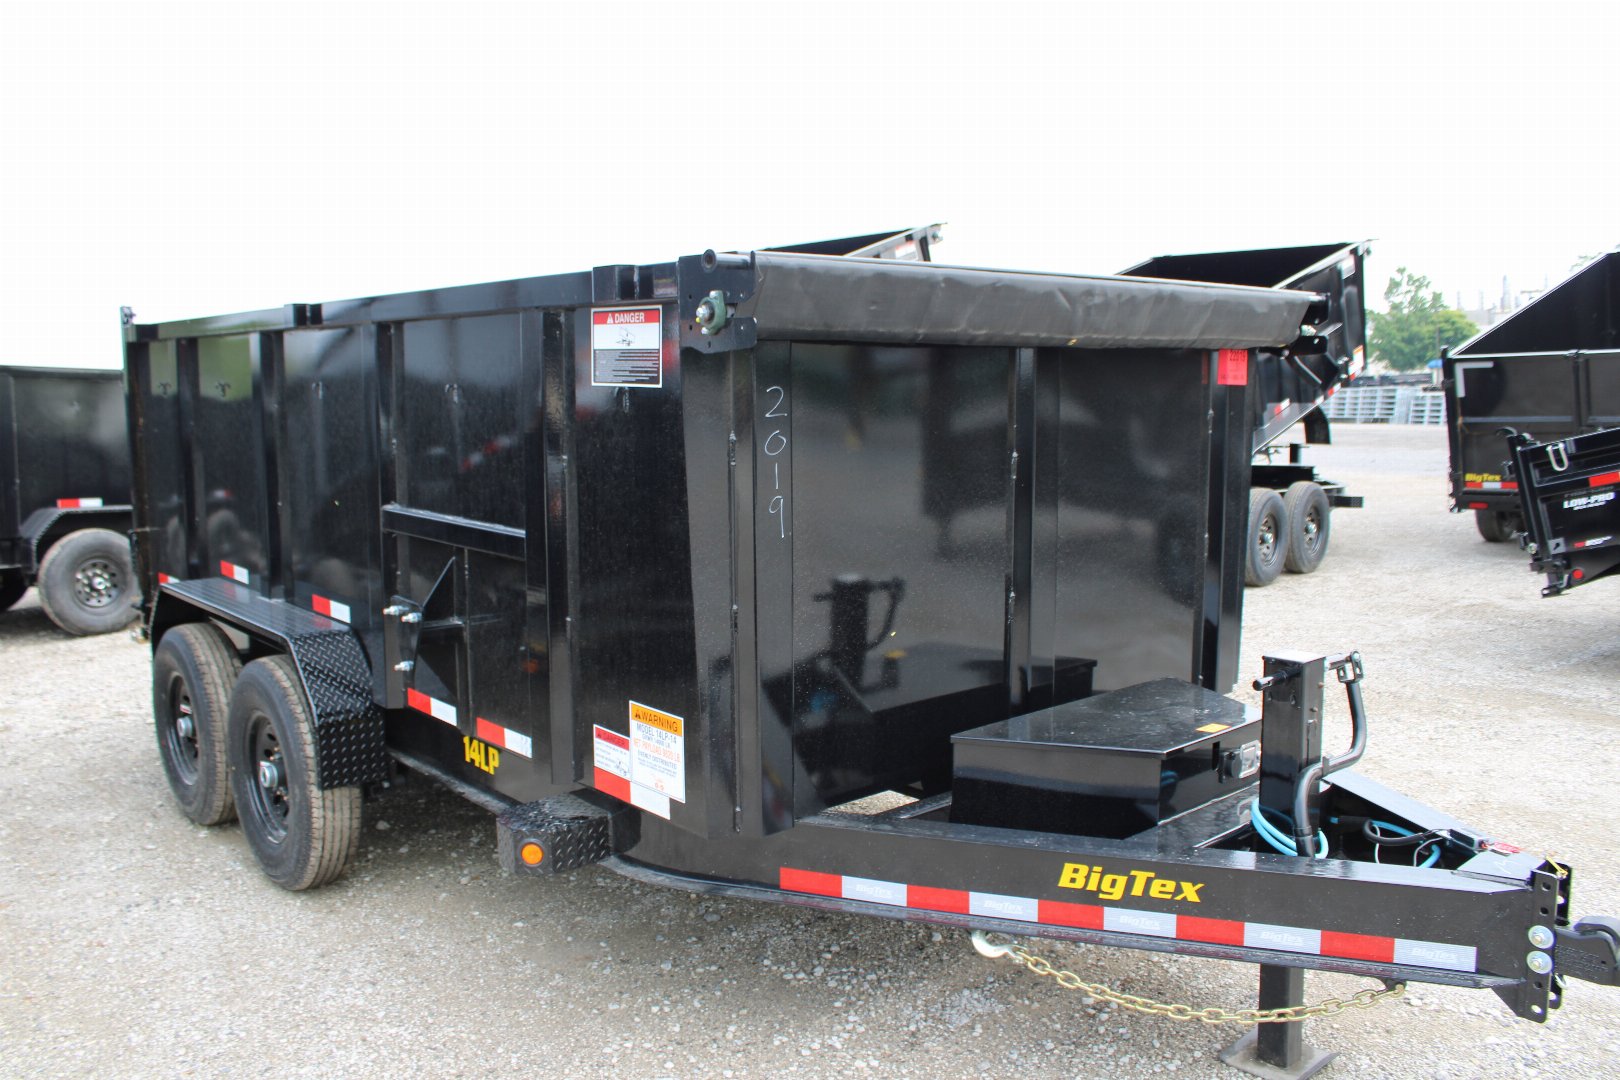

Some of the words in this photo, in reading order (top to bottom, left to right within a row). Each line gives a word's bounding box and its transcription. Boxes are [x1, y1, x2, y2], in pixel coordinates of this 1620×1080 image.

[614, 312, 645, 324] DANGER
[765, 386, 788, 538] 2019
[641, 710, 678, 733] WARNING
[463, 735, 499, 775] 14LP
[1058, 863, 1205, 903] BigTex
